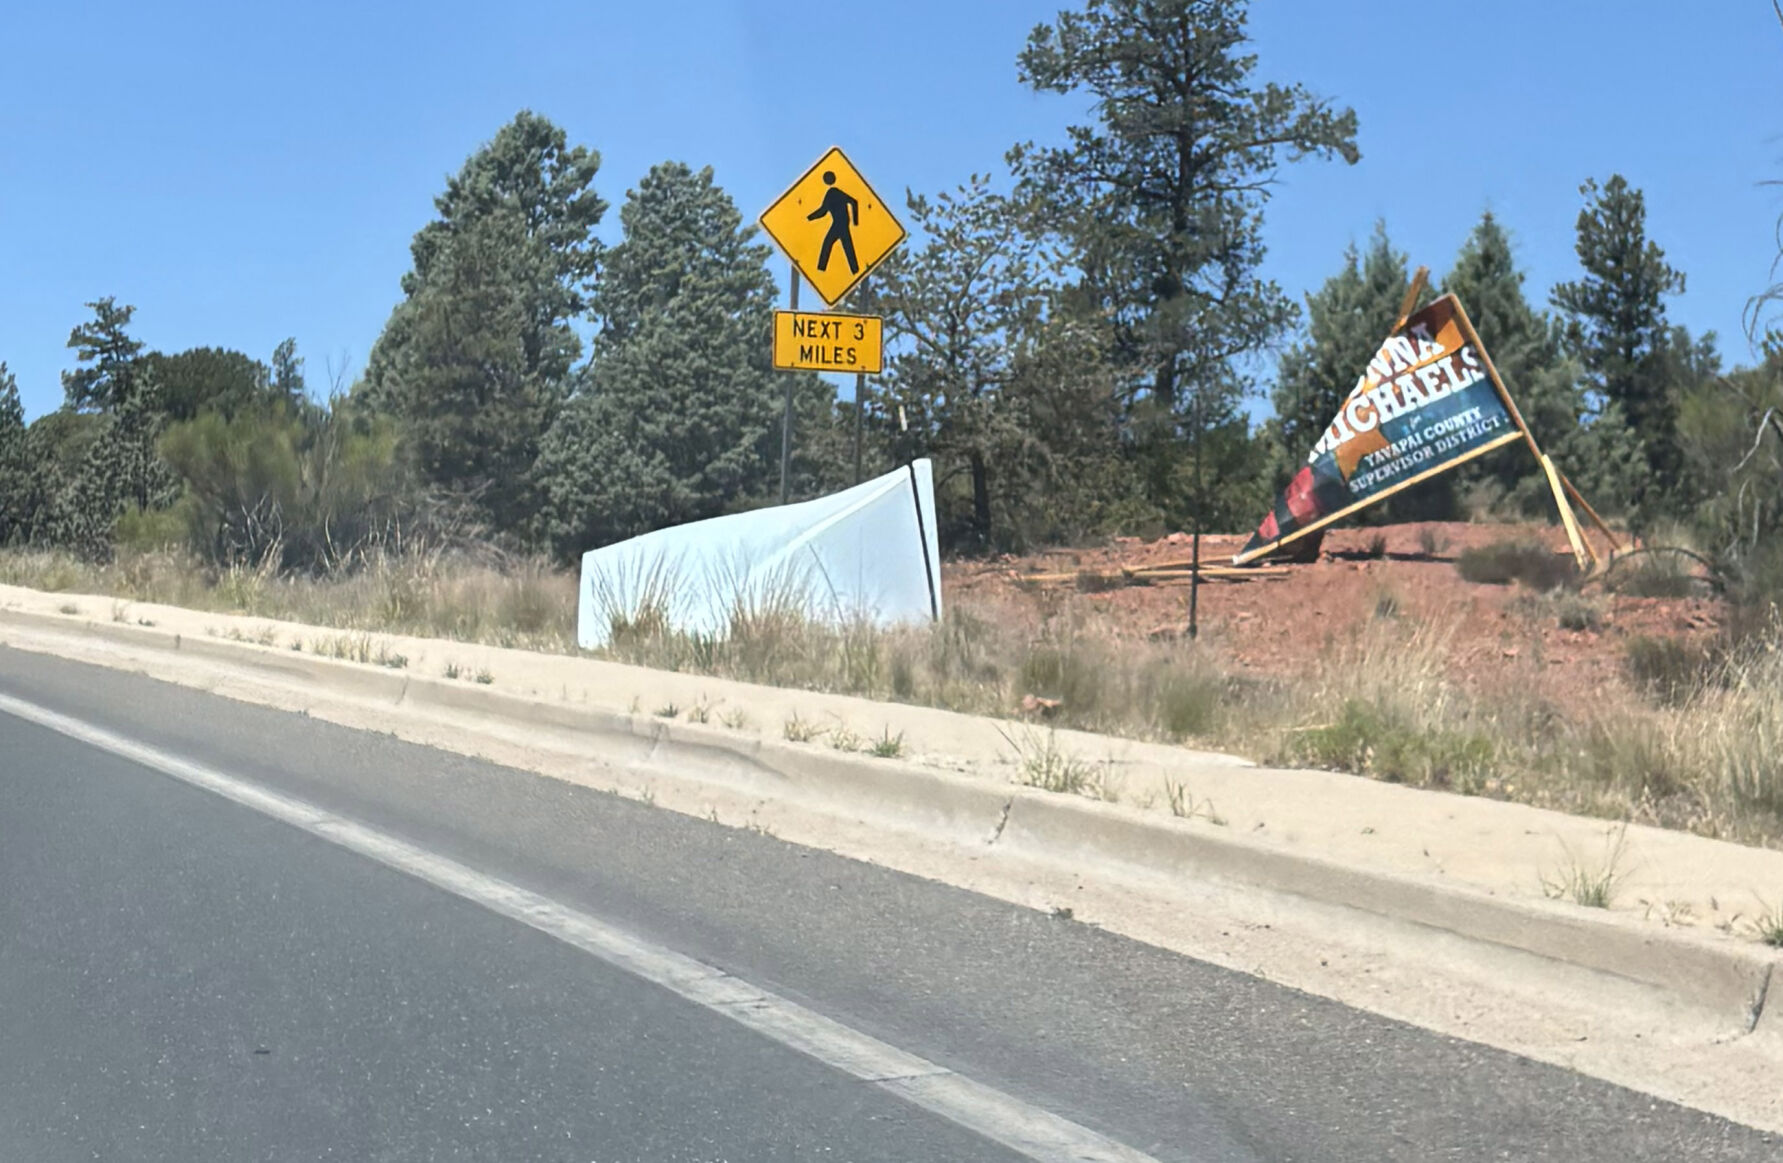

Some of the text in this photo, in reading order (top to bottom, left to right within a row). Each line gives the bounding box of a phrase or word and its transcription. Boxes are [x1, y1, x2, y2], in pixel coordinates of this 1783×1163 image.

[793, 319, 864, 341] NEXT 3
[800, 345, 857, 365] MILES
[1349, 322, 1445, 398] NNA
[1349, 416, 1500, 493] SUPERVISOR DISTRICT
[1364, 433, 1423, 467] YAVAPAI
[1423, 406, 1482, 440] COUNTY
